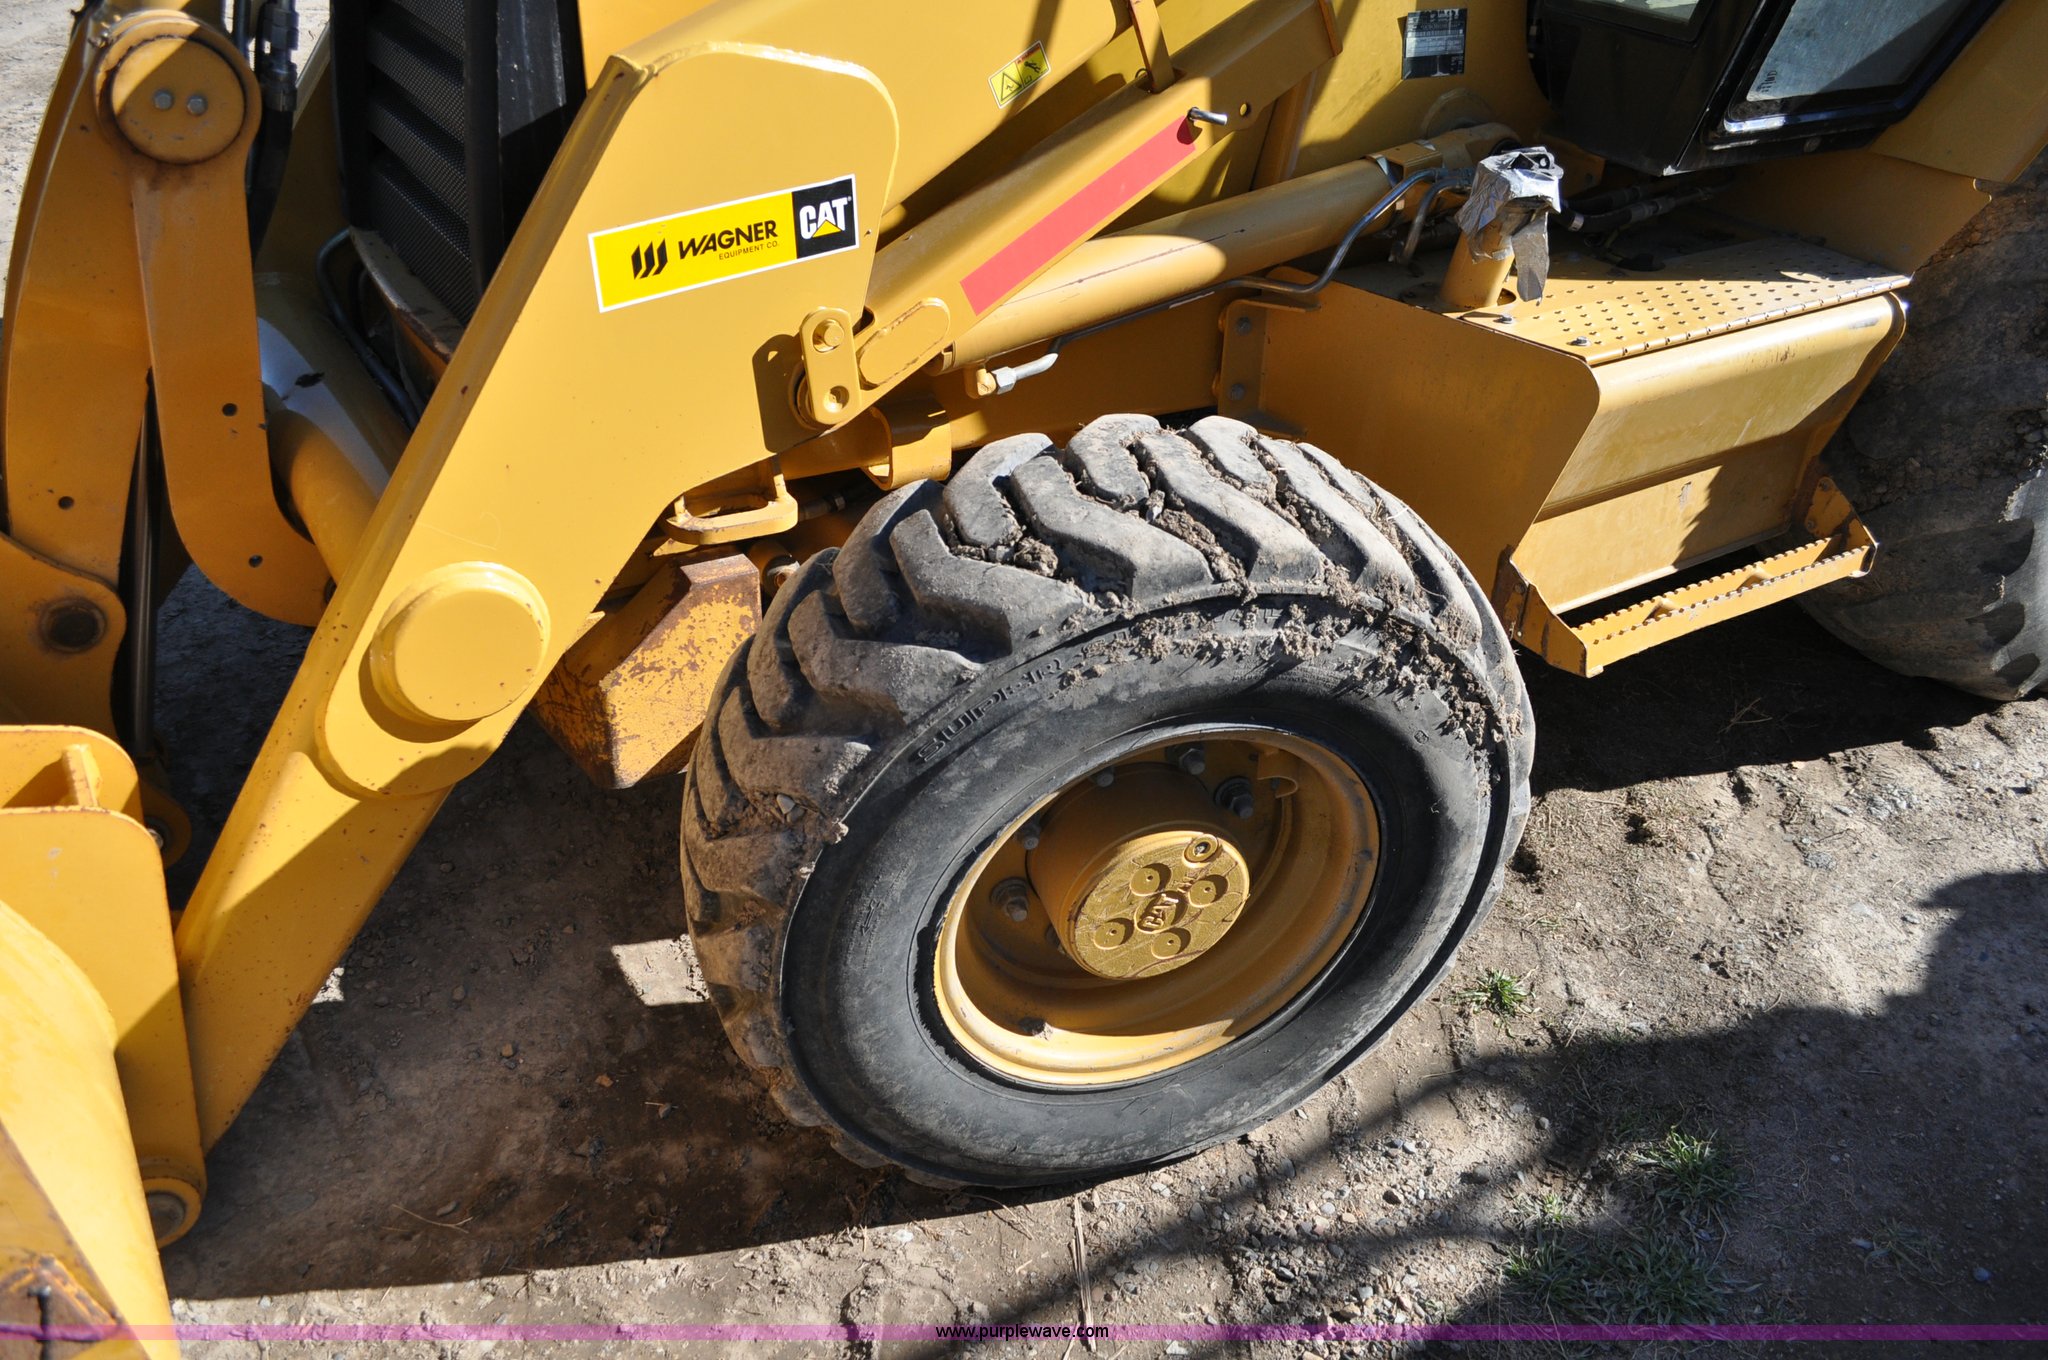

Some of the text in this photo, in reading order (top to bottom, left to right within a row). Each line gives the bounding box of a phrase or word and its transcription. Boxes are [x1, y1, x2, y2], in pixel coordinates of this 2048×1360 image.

[799, 197, 848, 240] CAT
[678, 220, 778, 260] WAGNER
[719, 240, 779, 260] EQUIPMENT CO.
